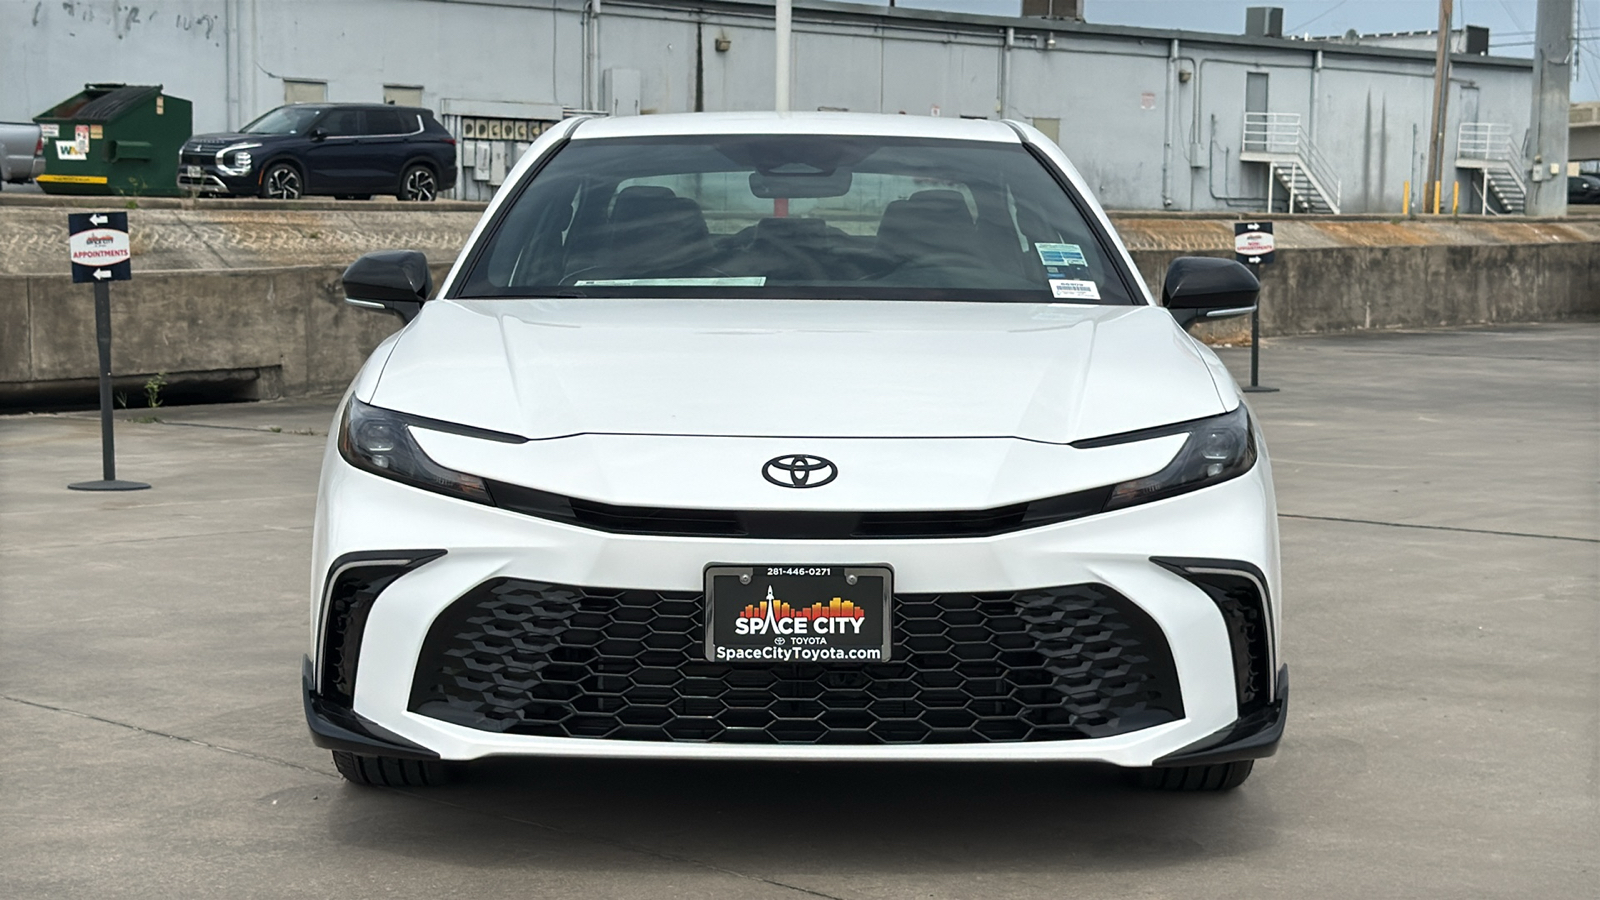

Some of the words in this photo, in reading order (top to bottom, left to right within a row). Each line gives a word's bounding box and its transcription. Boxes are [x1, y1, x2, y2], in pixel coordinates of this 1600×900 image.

[73, 249, 128, 258] APPOINTMENTS
[767, 567, 831, 576] 281-446-0271
[735, 606, 808, 635] SPACE
[813, 617, 865, 634] CITY
[790, 636, 827, 645] TOYOTA
[716, 646, 881, 661] SpaceCityToyota.com
